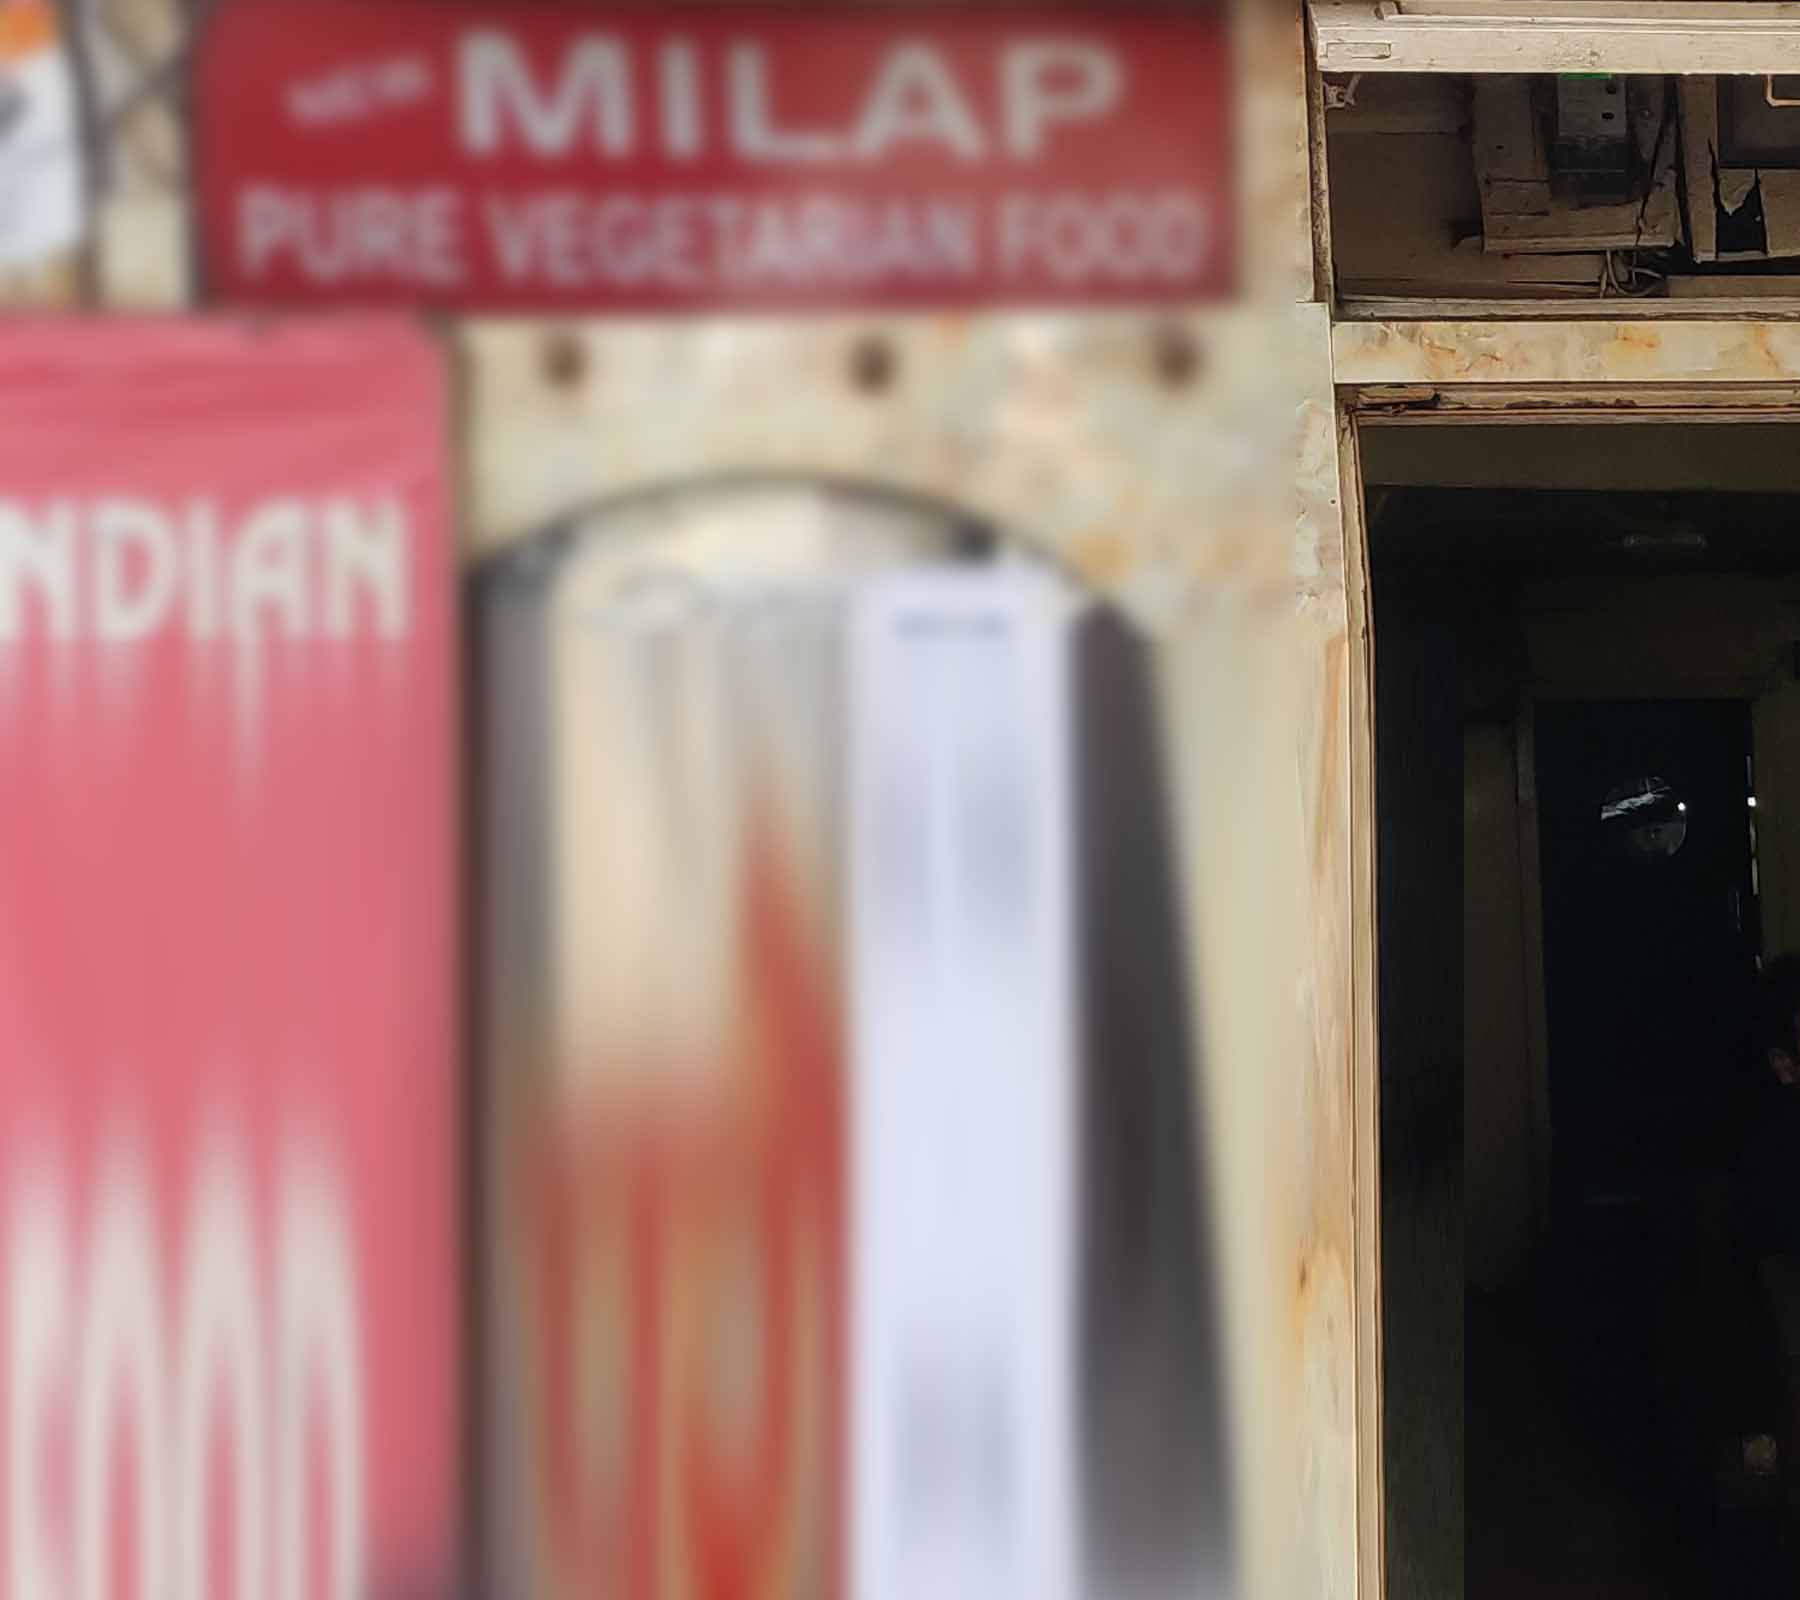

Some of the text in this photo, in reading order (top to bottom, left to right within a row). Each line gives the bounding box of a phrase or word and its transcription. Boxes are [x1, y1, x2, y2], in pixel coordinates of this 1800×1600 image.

[455, 28, 1126, 164] MILAP
[241, 190, 462, 286] PURE
[1000, 193, 1208, 284] FOOD
